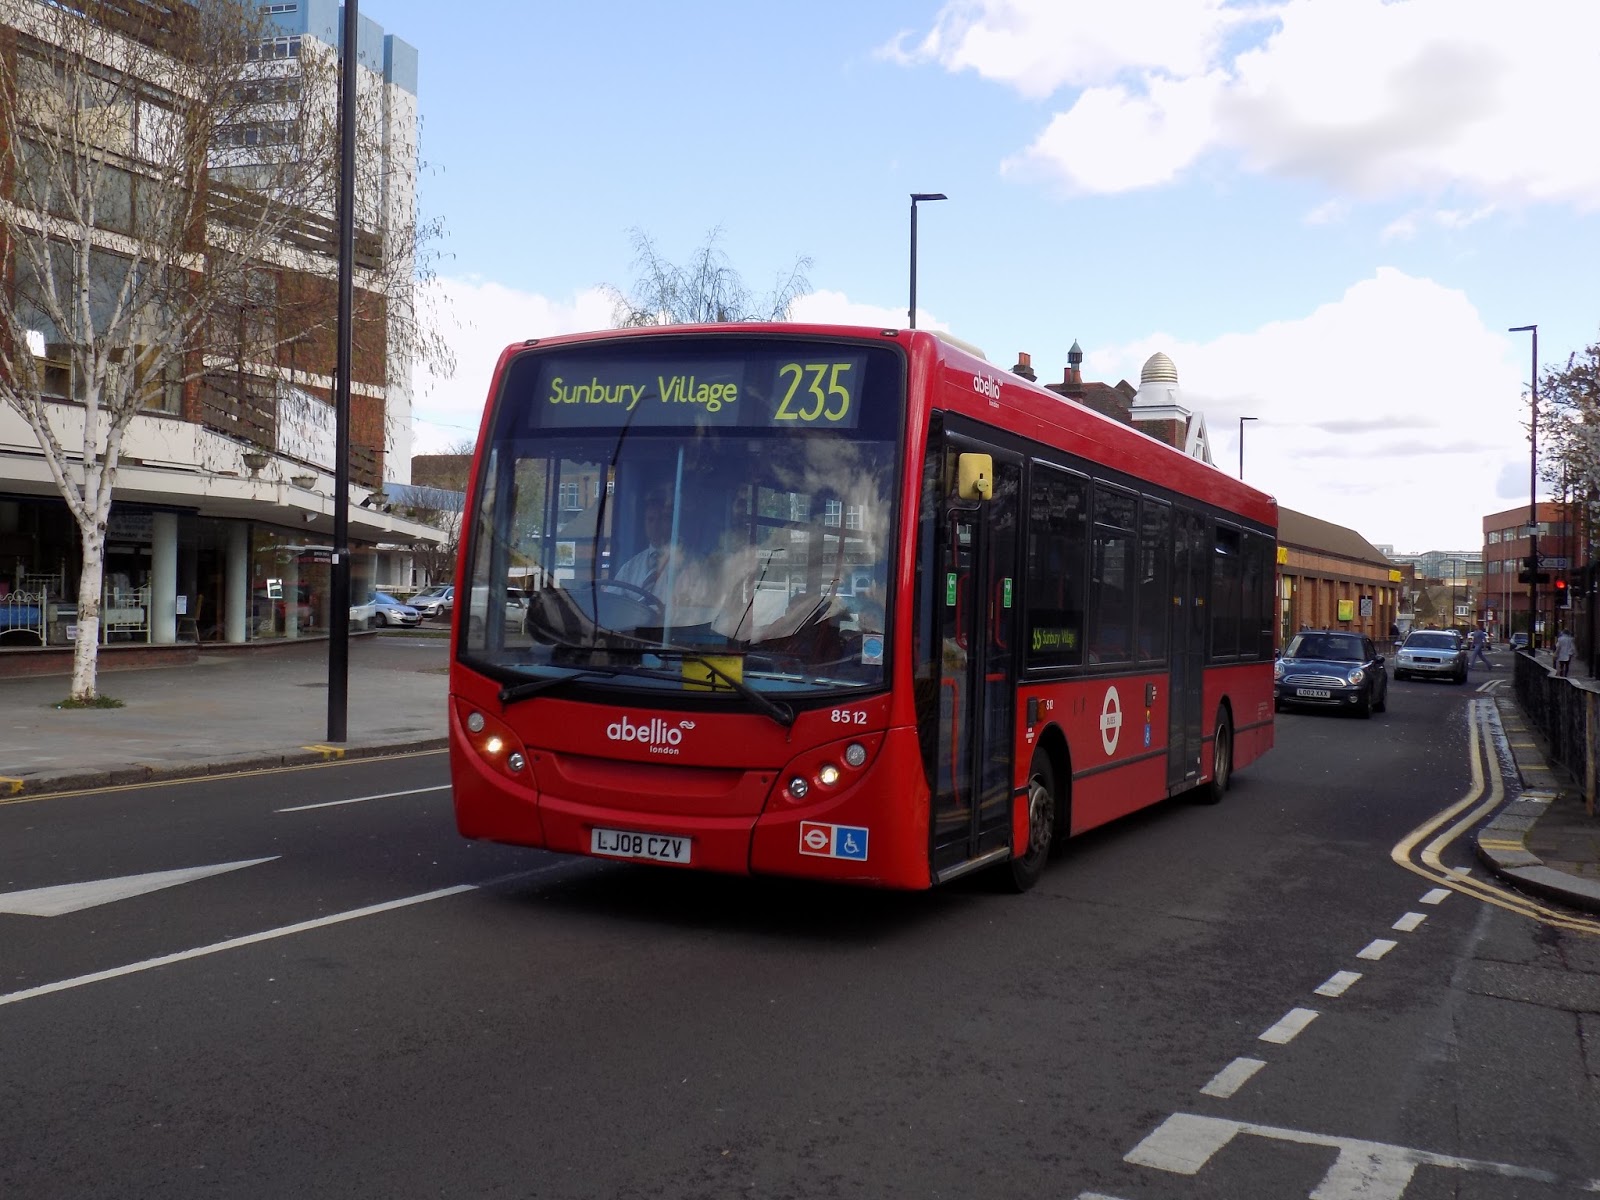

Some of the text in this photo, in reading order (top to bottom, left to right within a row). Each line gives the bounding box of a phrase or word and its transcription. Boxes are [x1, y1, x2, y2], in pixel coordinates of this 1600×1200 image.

[549, 375, 738, 412] Sunbury Village
[774, 362, 852, 421] 235
[973, 370, 1000, 399] abellio
[606, 716, 683, 746] abellio
[830, 709, 867, 725] 8512
[649, 745, 680, 755] london
[597, 830, 683, 858] LJ08 CZV
